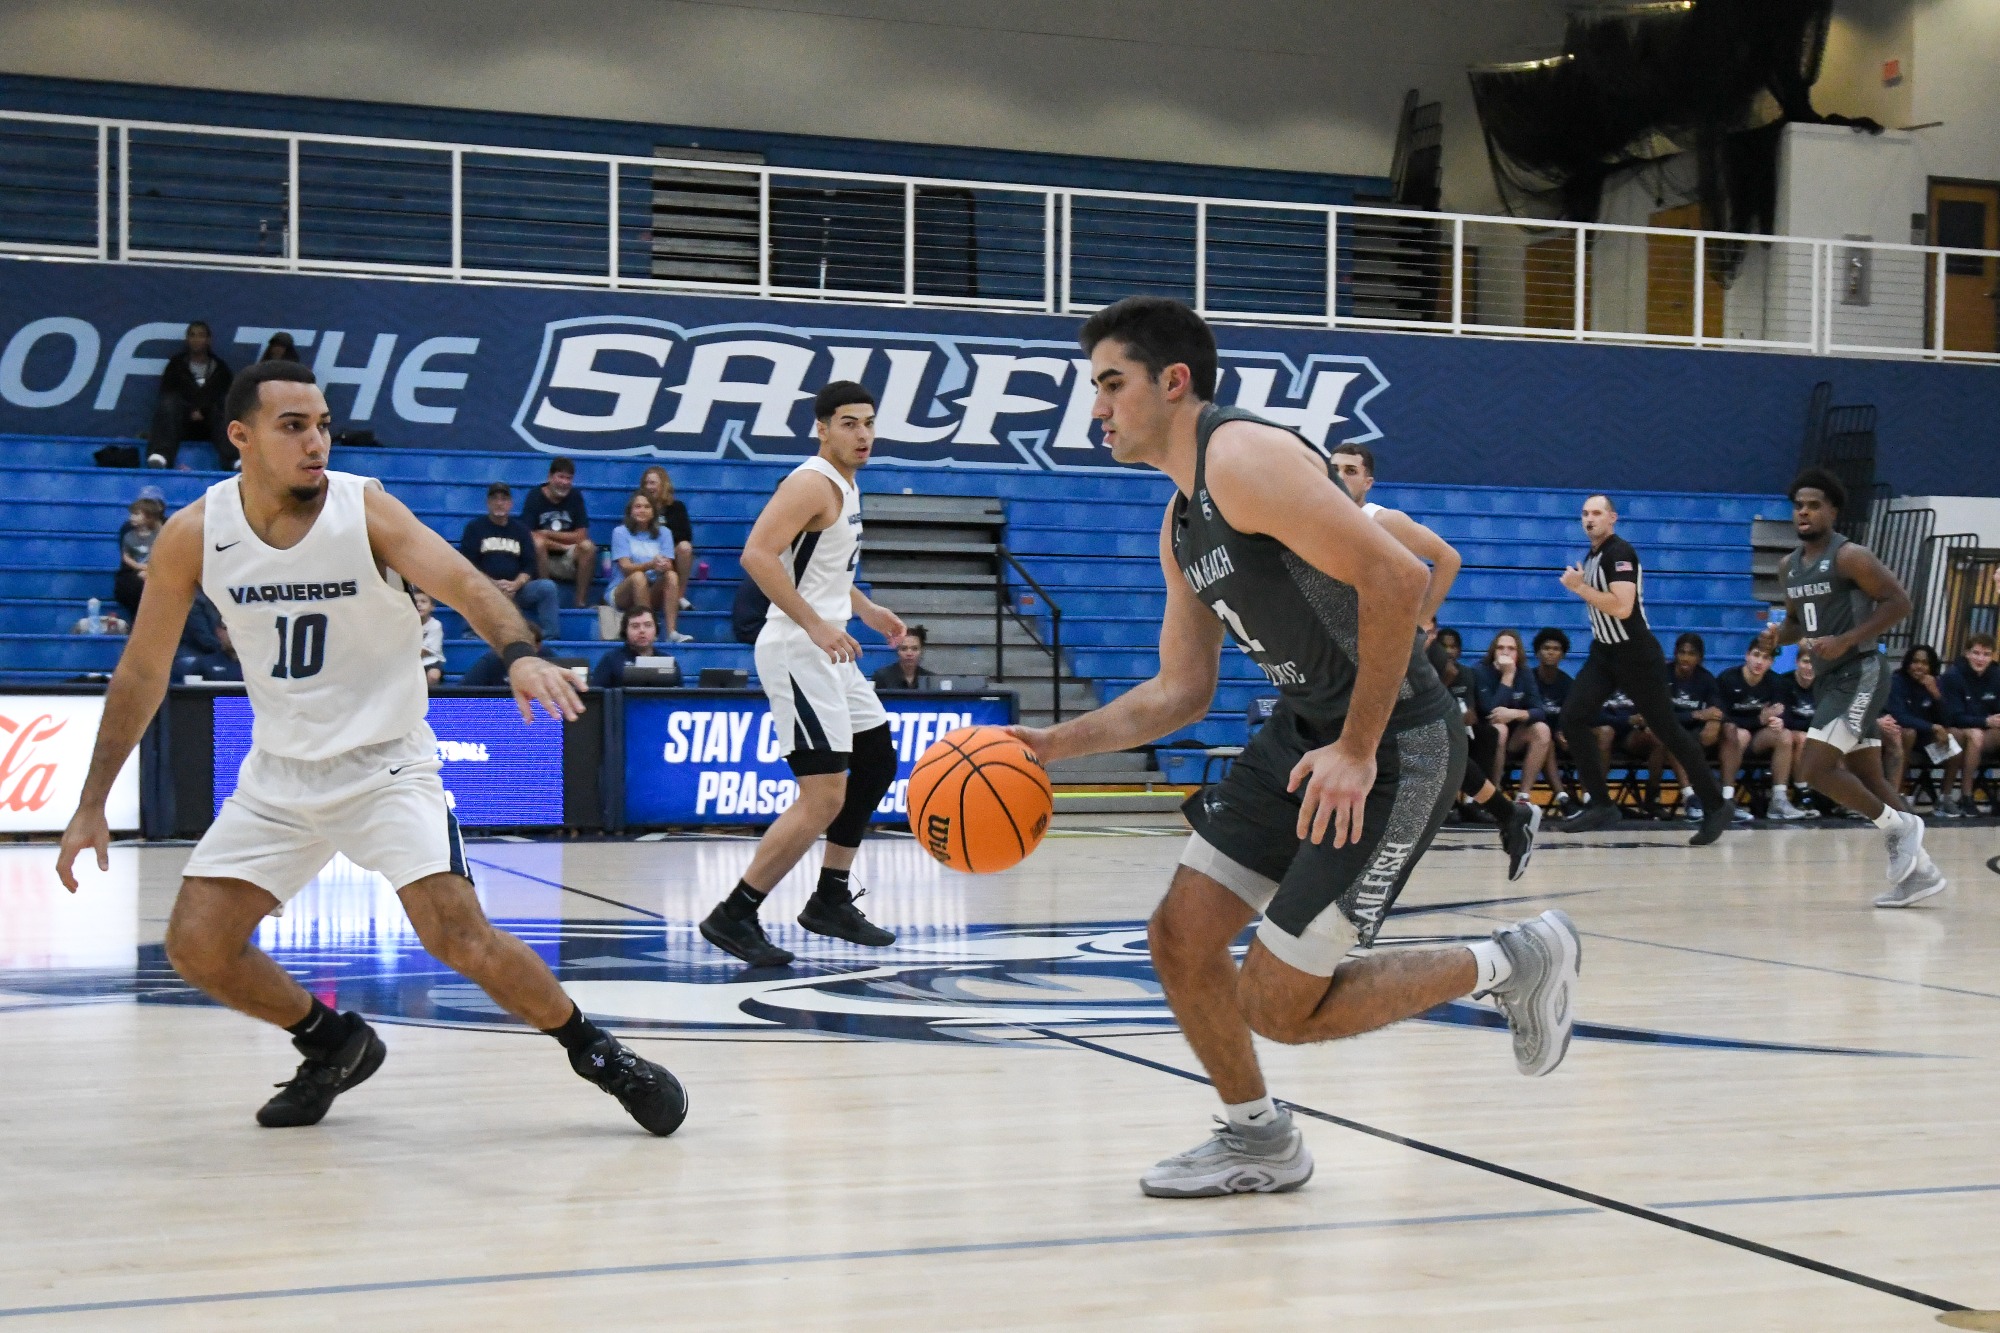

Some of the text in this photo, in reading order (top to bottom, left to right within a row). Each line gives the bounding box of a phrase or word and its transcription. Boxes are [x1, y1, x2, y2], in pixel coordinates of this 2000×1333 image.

[0, 316, 191, 411] OF
[533, 333, 1361, 457] SALFIH
[227, 579, 358, 605] VAQUEROS
[1803, 602, 1818, 632] 0
[271, 613, 328, 679] 10
[664, 711, 753, 763] STAY
